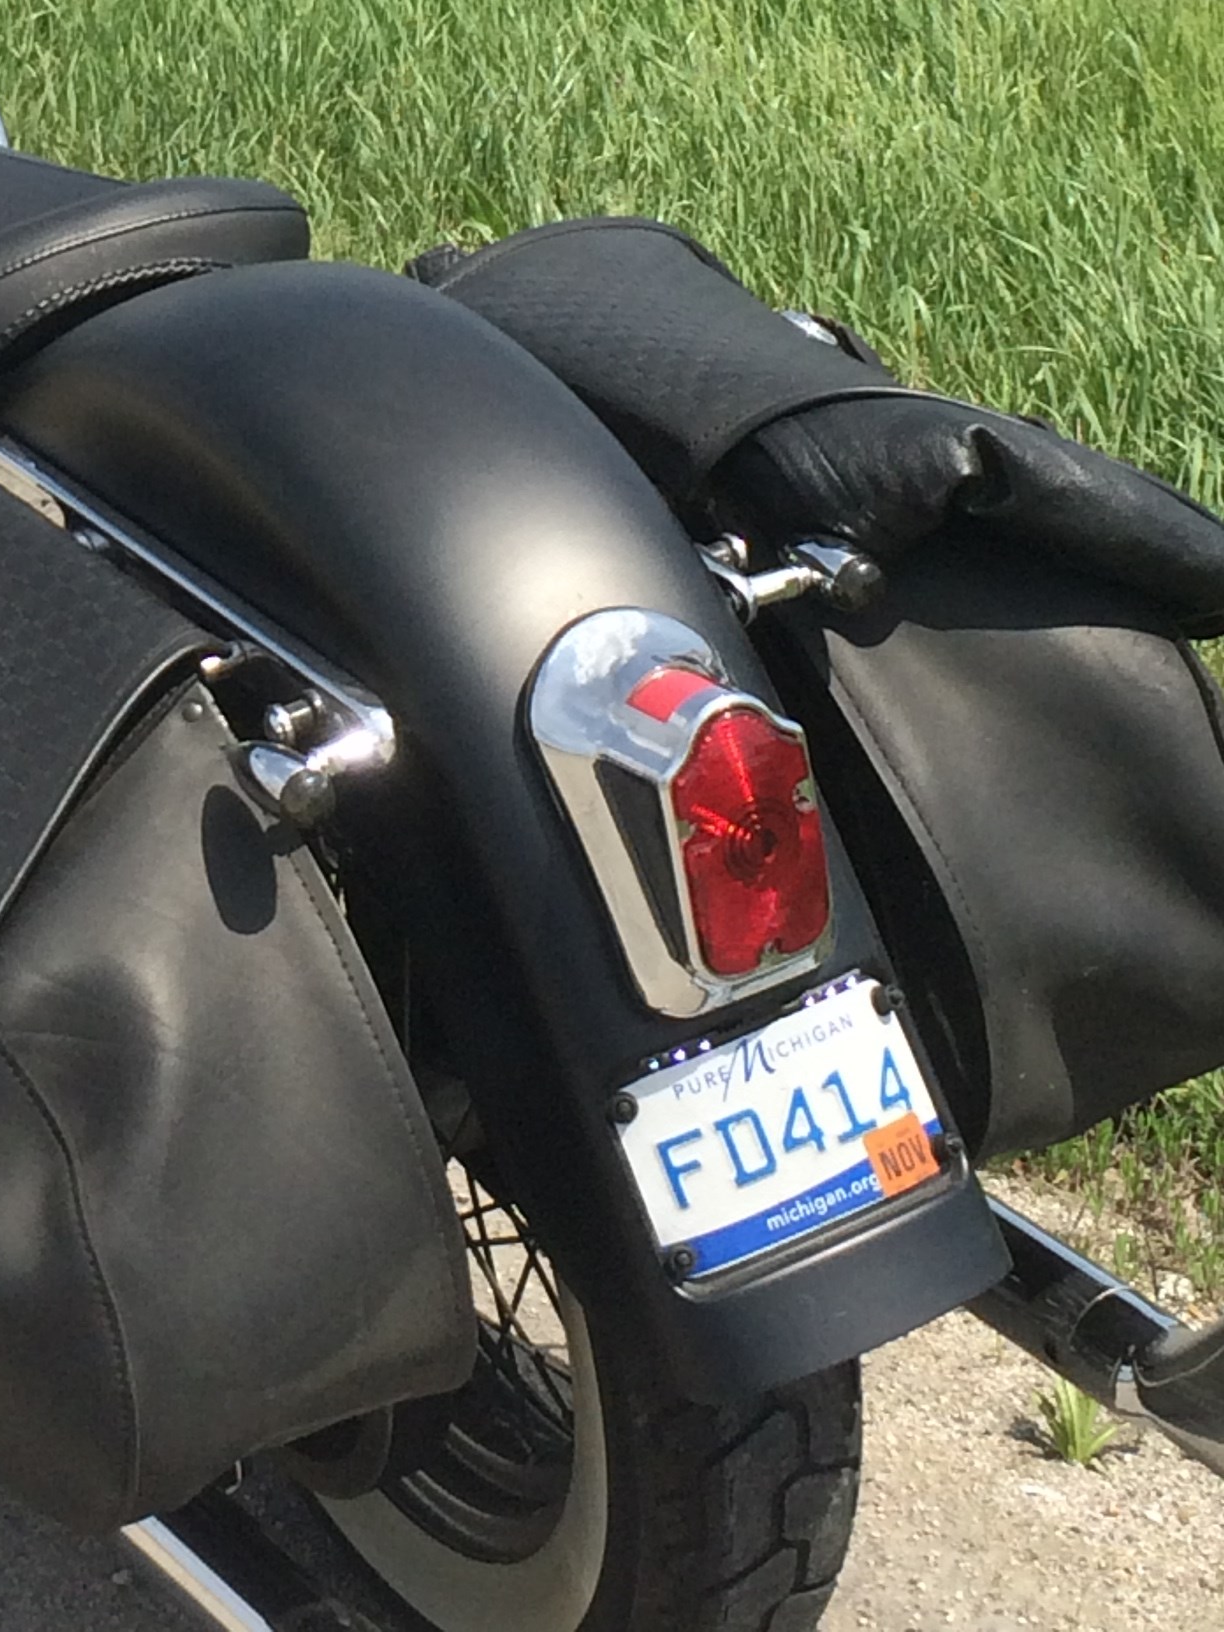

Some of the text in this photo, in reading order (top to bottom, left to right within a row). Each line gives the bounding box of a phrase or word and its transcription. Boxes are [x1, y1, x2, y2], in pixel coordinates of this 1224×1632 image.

[672, 1013, 854, 1102] PURE MICHIGAN
[656, 1047, 912, 1210] FD414
[878, 1135, 926, 1181] NOV
[766, 1173, 879, 1231] michigan.org
